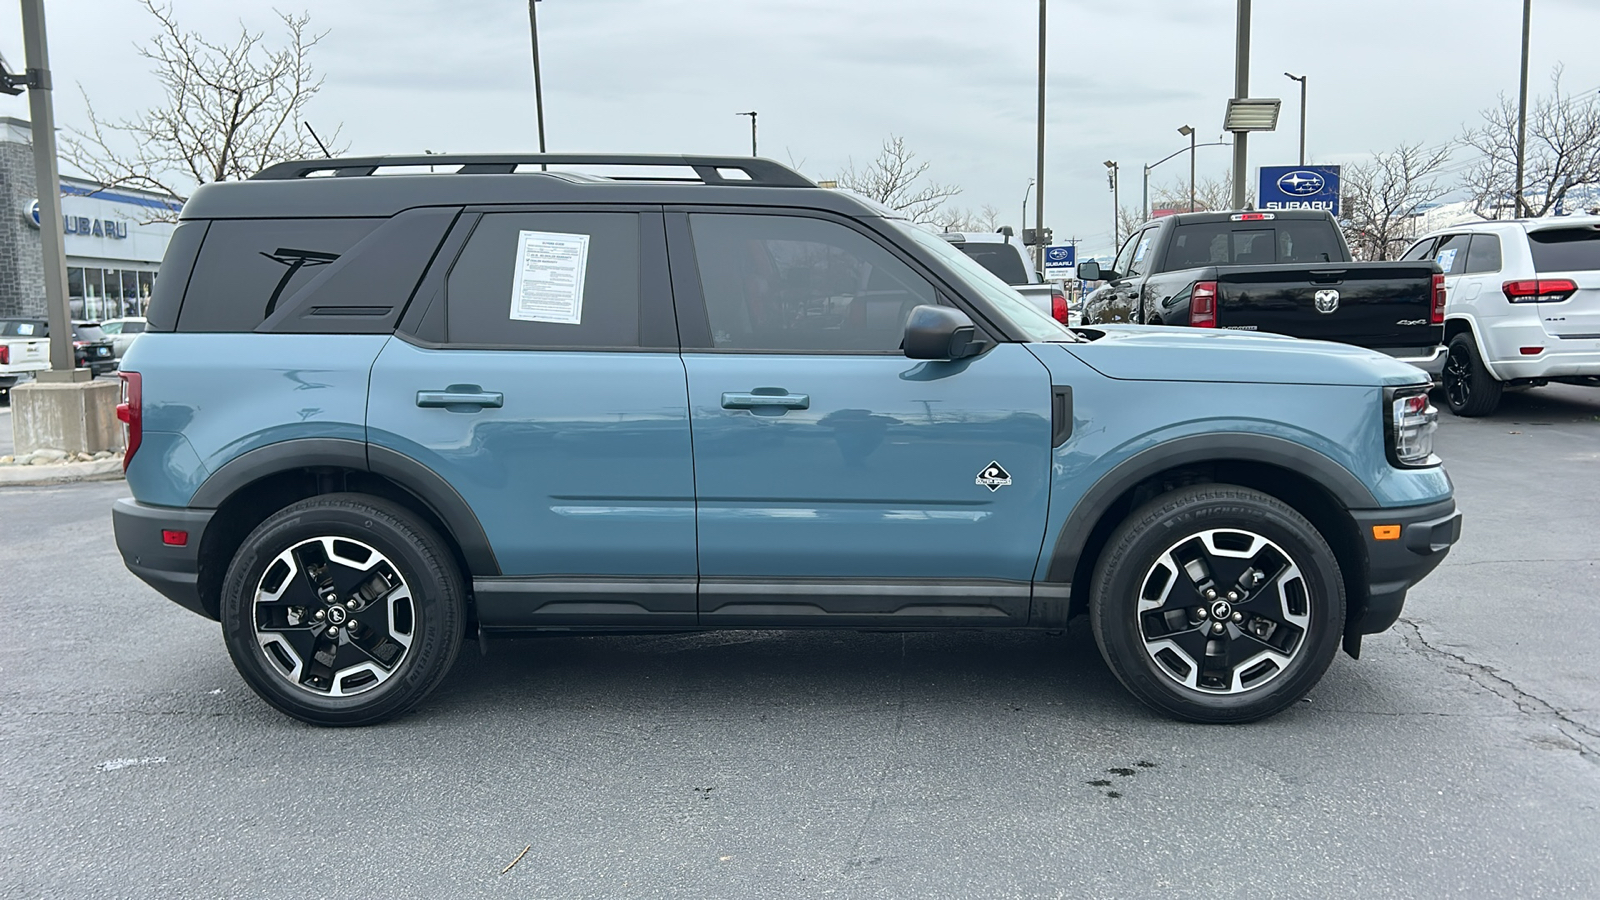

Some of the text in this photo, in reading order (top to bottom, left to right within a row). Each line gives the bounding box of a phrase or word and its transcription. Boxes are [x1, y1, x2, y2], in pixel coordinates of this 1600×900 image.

[1266, 201, 1334, 211] SUBARU
[64, 214, 127, 239] UBARU
[1195, 506, 1263, 519] MICHELIN
[409, 626, 435, 682] MICHELIN
